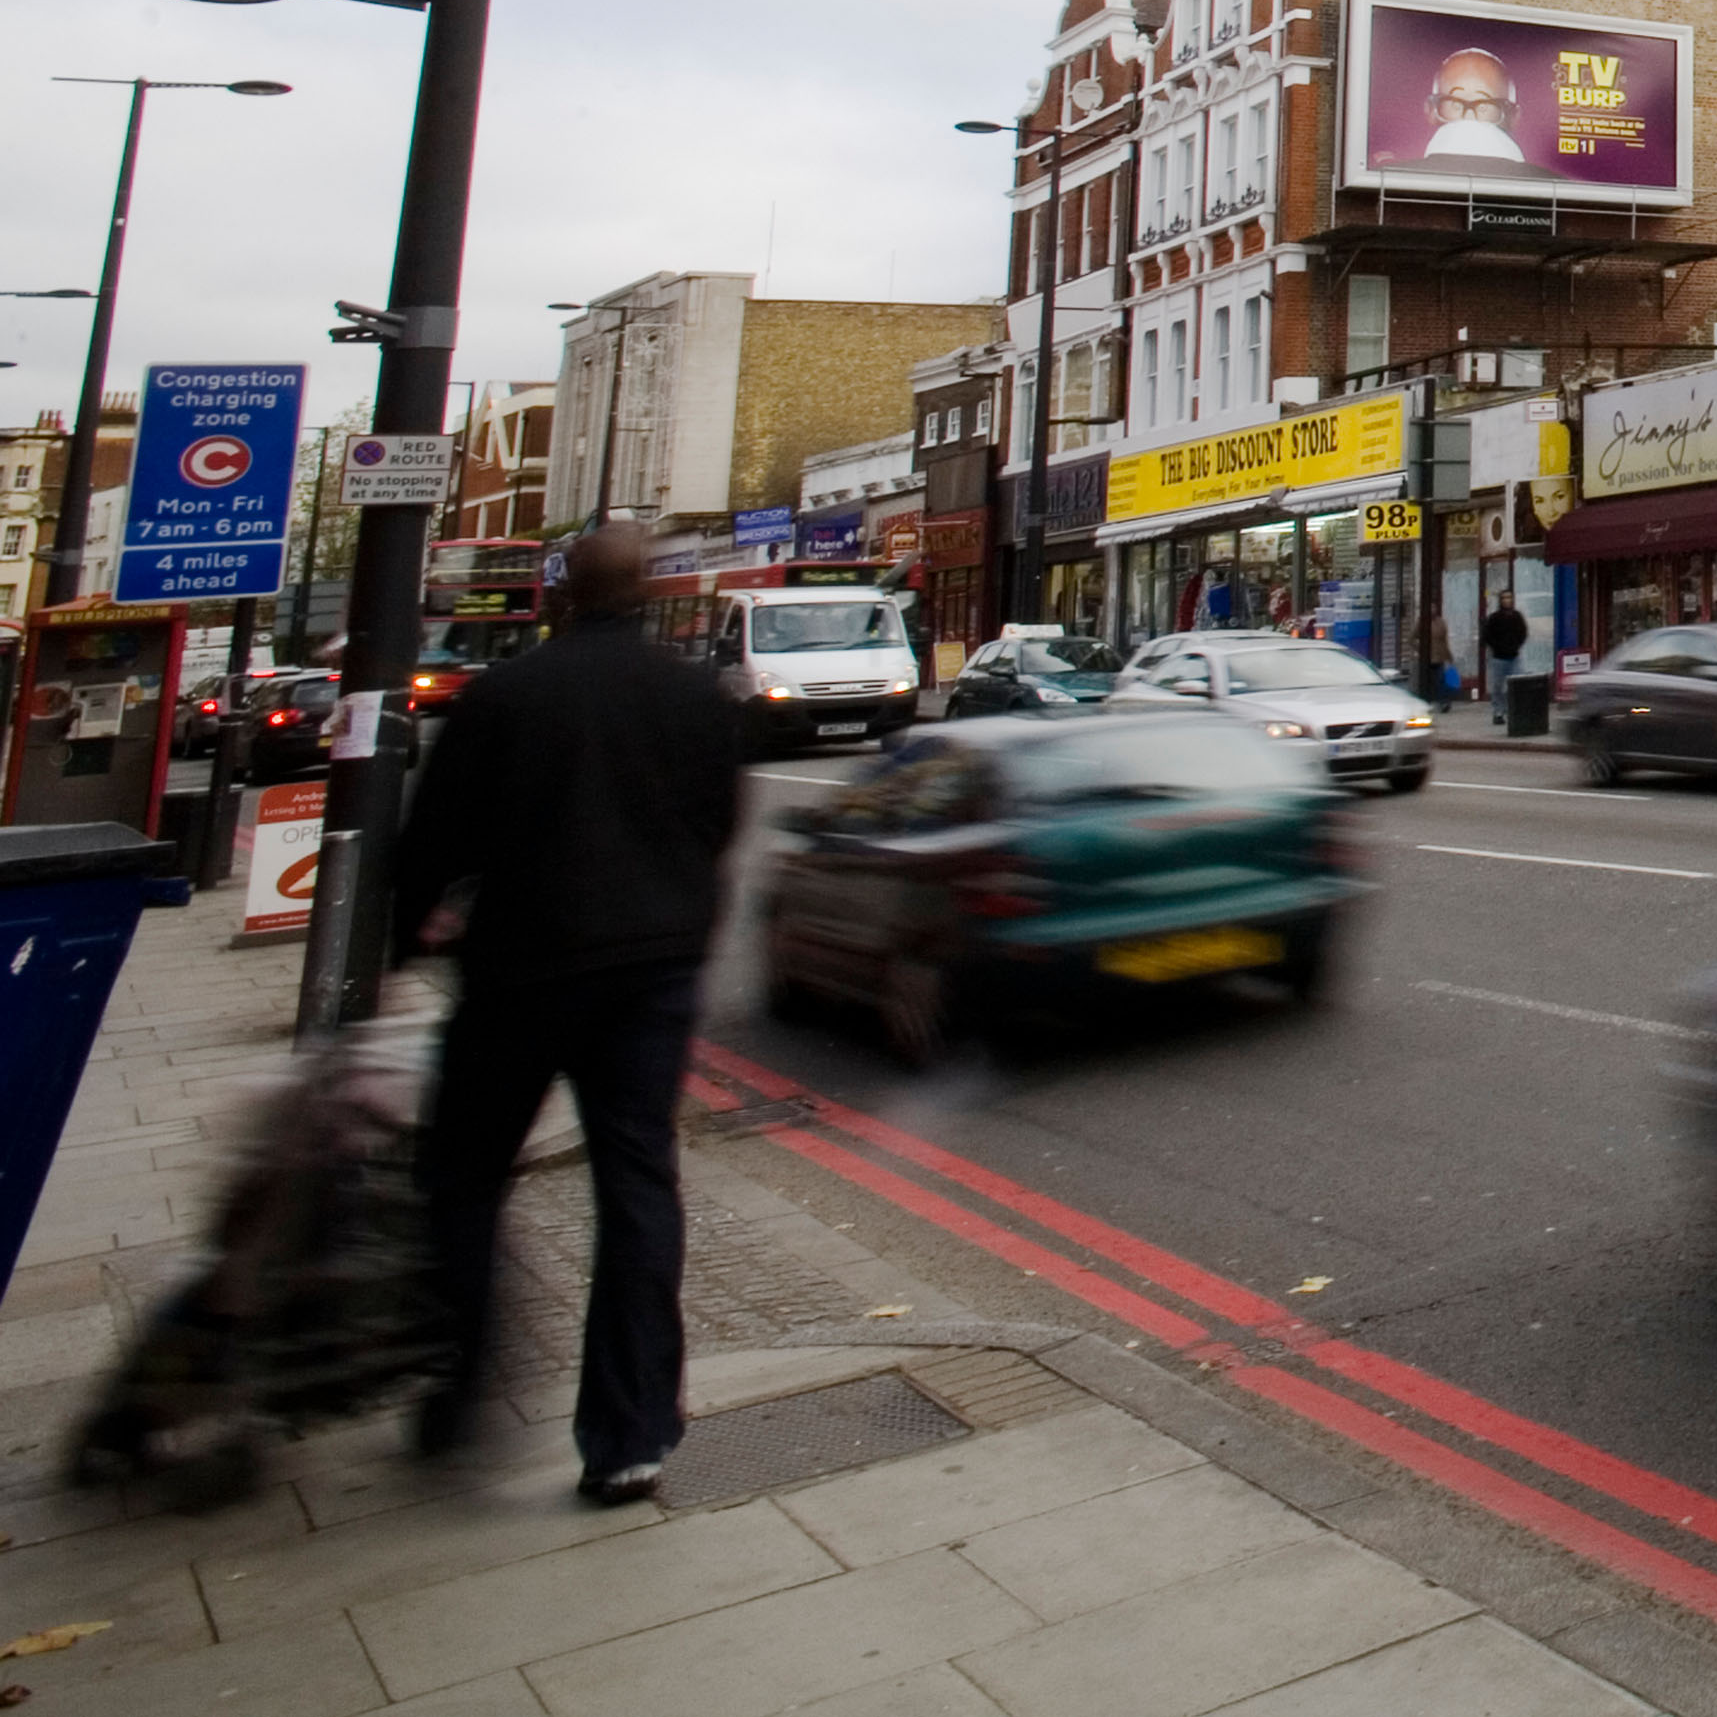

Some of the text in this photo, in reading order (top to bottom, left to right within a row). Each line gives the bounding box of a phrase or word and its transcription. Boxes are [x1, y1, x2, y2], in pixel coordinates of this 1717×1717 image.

[1559, 51, 1619, 88] TV
[1559, 87, 1626, 108] BURP
[157, 369, 297, 390] Congestion
[170, 390, 278, 409] charging
[192, 413, 251, 426] zone
[403, 443, 438, 452] RED
[1159, 414, 1339, 487] THE BIG DISCOUNT STORE
[390, 454, 447, 465] ROUTE
[350, 474, 443, 487] No stopping
[1618, 464, 1671, 489] passion
[351, 487, 438, 500] at any time
[156, 498, 211, 515] Mon
[232, 495, 264, 511] Fri
[1375, 530, 1410, 540] PLUS
[156, 552, 248, 571] 4 miles
[161, 571, 237, 592] ahead
